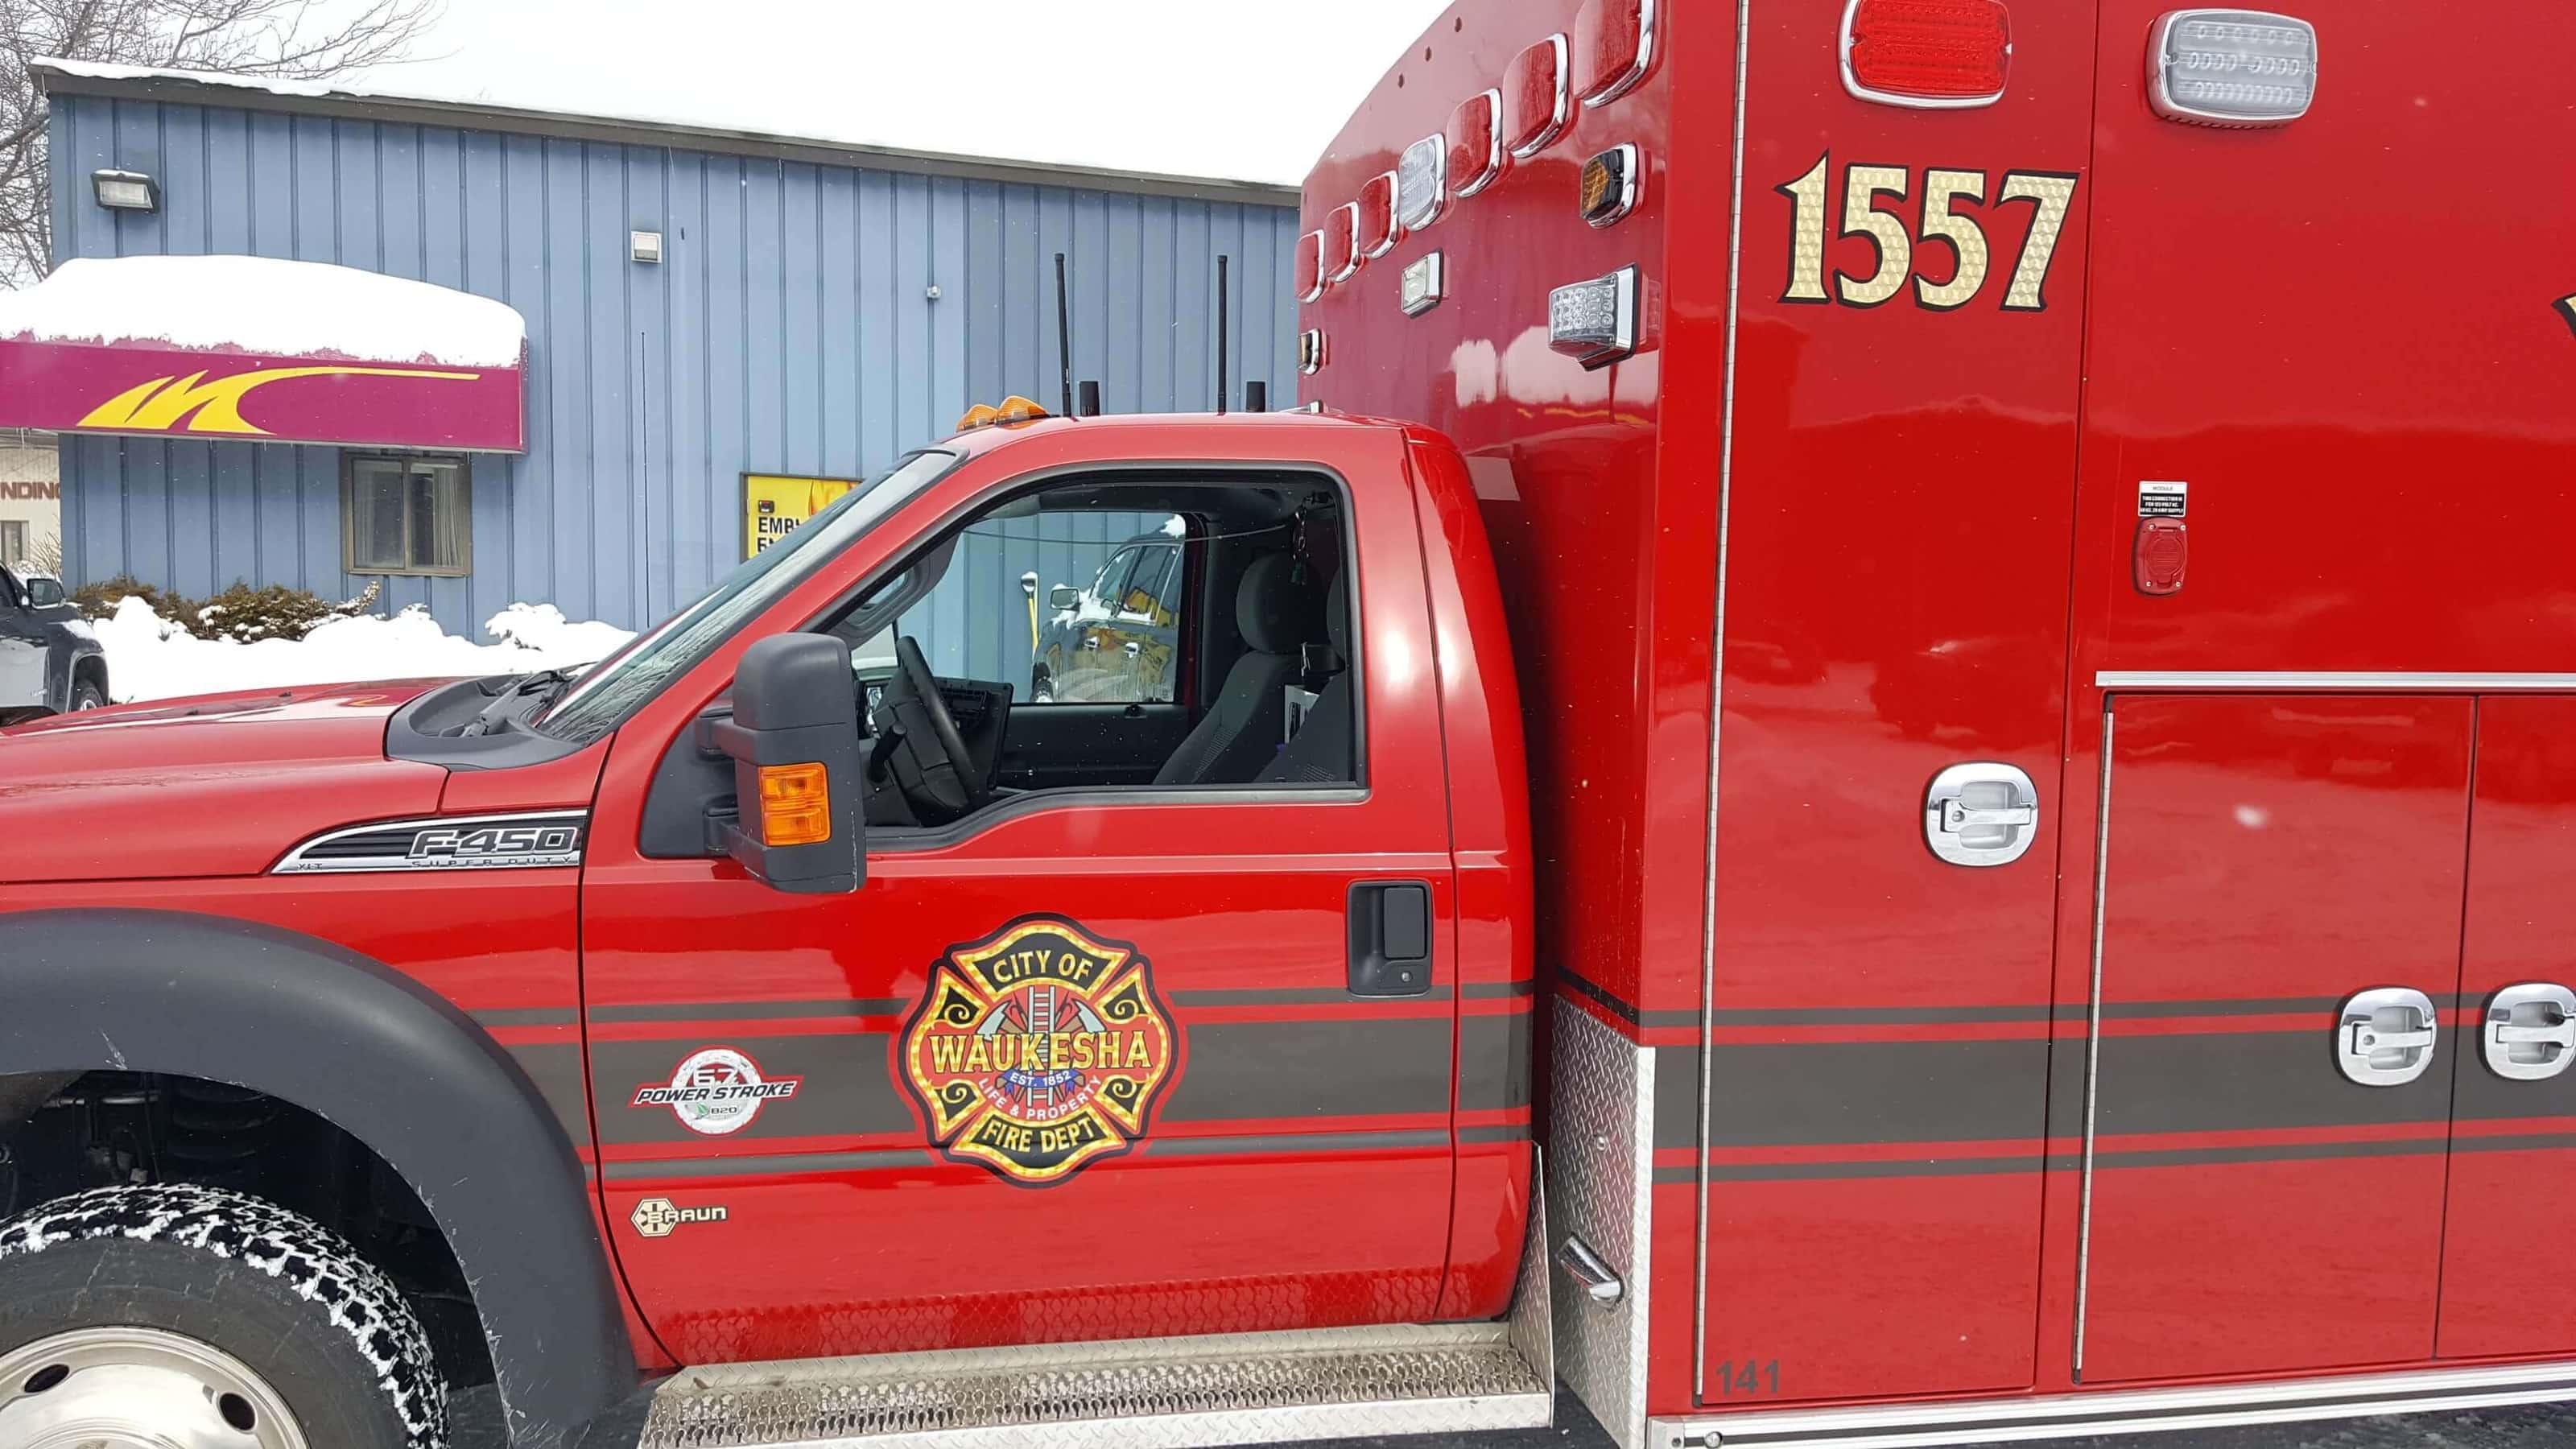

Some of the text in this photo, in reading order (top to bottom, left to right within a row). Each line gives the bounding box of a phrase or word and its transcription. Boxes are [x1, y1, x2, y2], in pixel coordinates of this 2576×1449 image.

[1773, 148, 2080, 312] 1557
[407, 828, 578, 858] F-450
[411, 857, 571, 867] SUPER DUTY
[993, 950, 1094, 984] CITY OF
[930, 1030, 1153, 1073] WAUKESHA
[635, 1082, 795, 1104] POWER STROKE
[1009, 1071, 1072, 1087] EST. 1852
[978, 1075, 1102, 1120] LIFE & PROPERTY
[981, 1117, 1096, 1154] FIRE DEPT
[646, 1207, 728, 1224] BRAUN
[1715, 1359, 1778, 1394] 141
